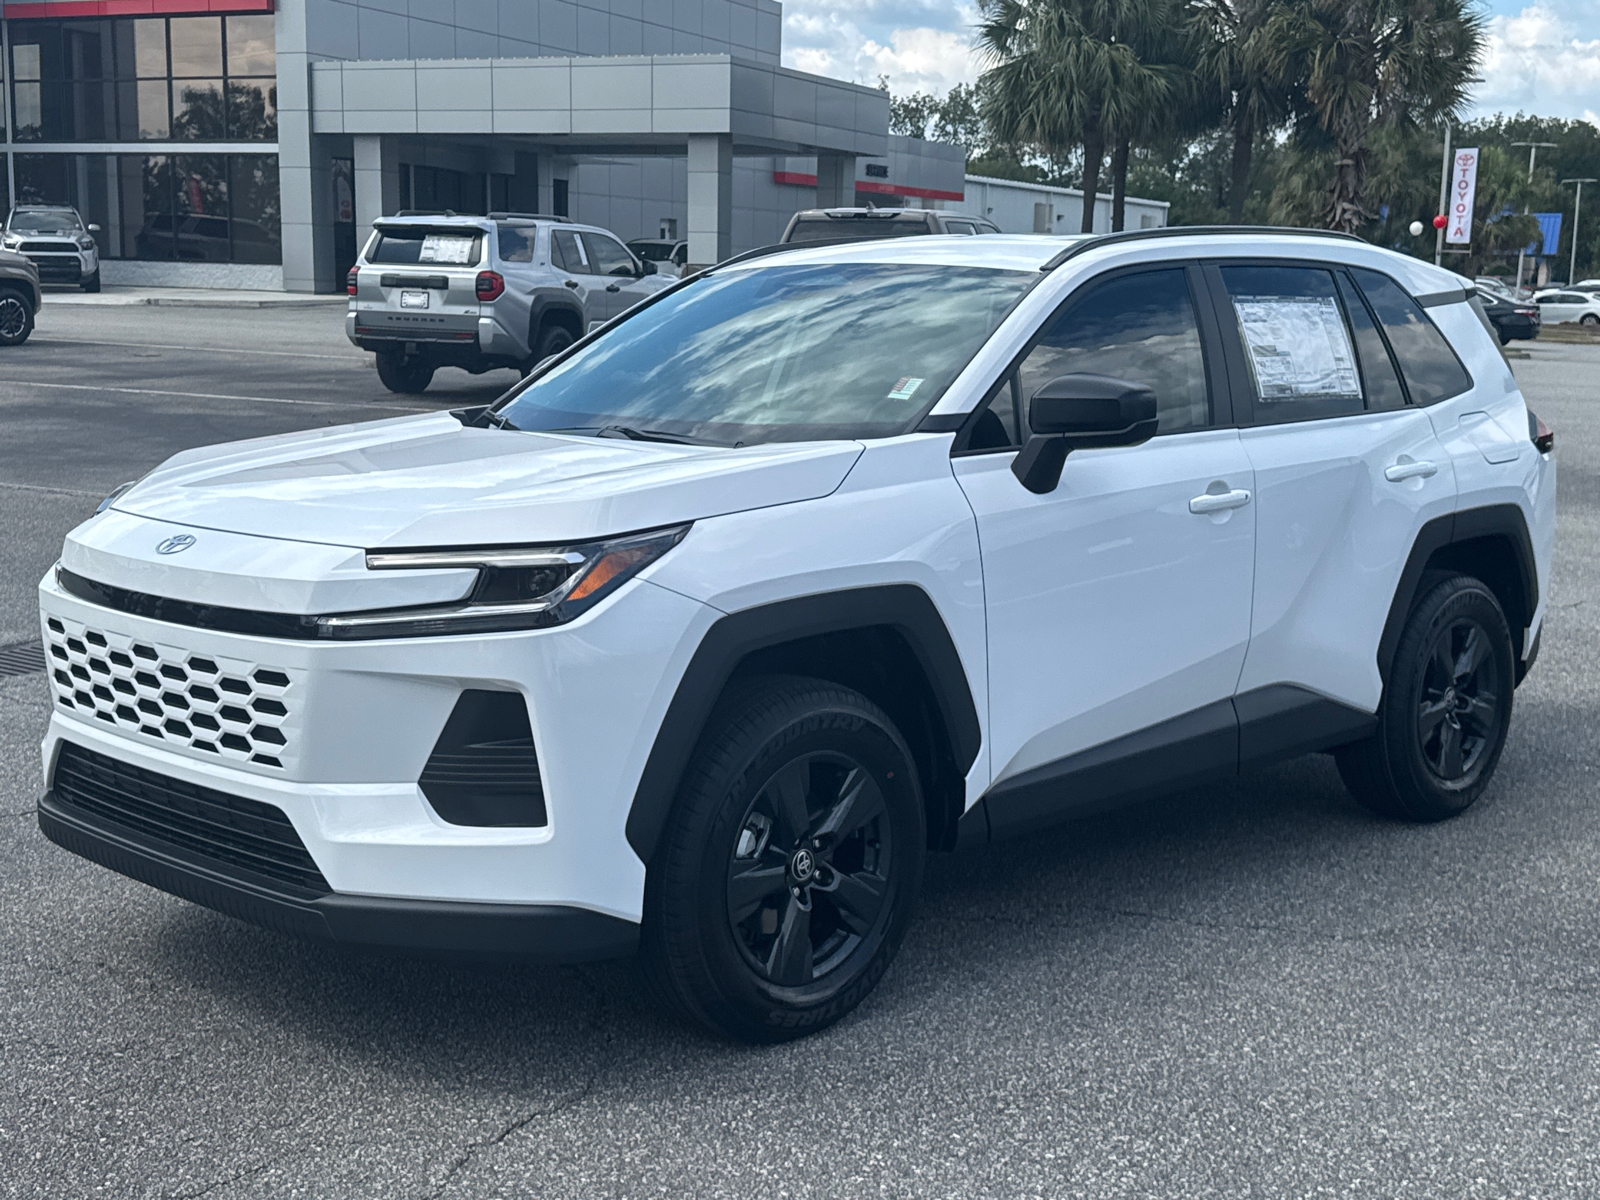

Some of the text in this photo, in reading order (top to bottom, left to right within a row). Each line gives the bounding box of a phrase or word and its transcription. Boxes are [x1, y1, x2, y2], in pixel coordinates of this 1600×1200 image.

[1454, 168, 1469, 237] TOYOTA
[756, 713, 866, 766] COUNTRY
[765, 1001, 839, 1029] TIRES
